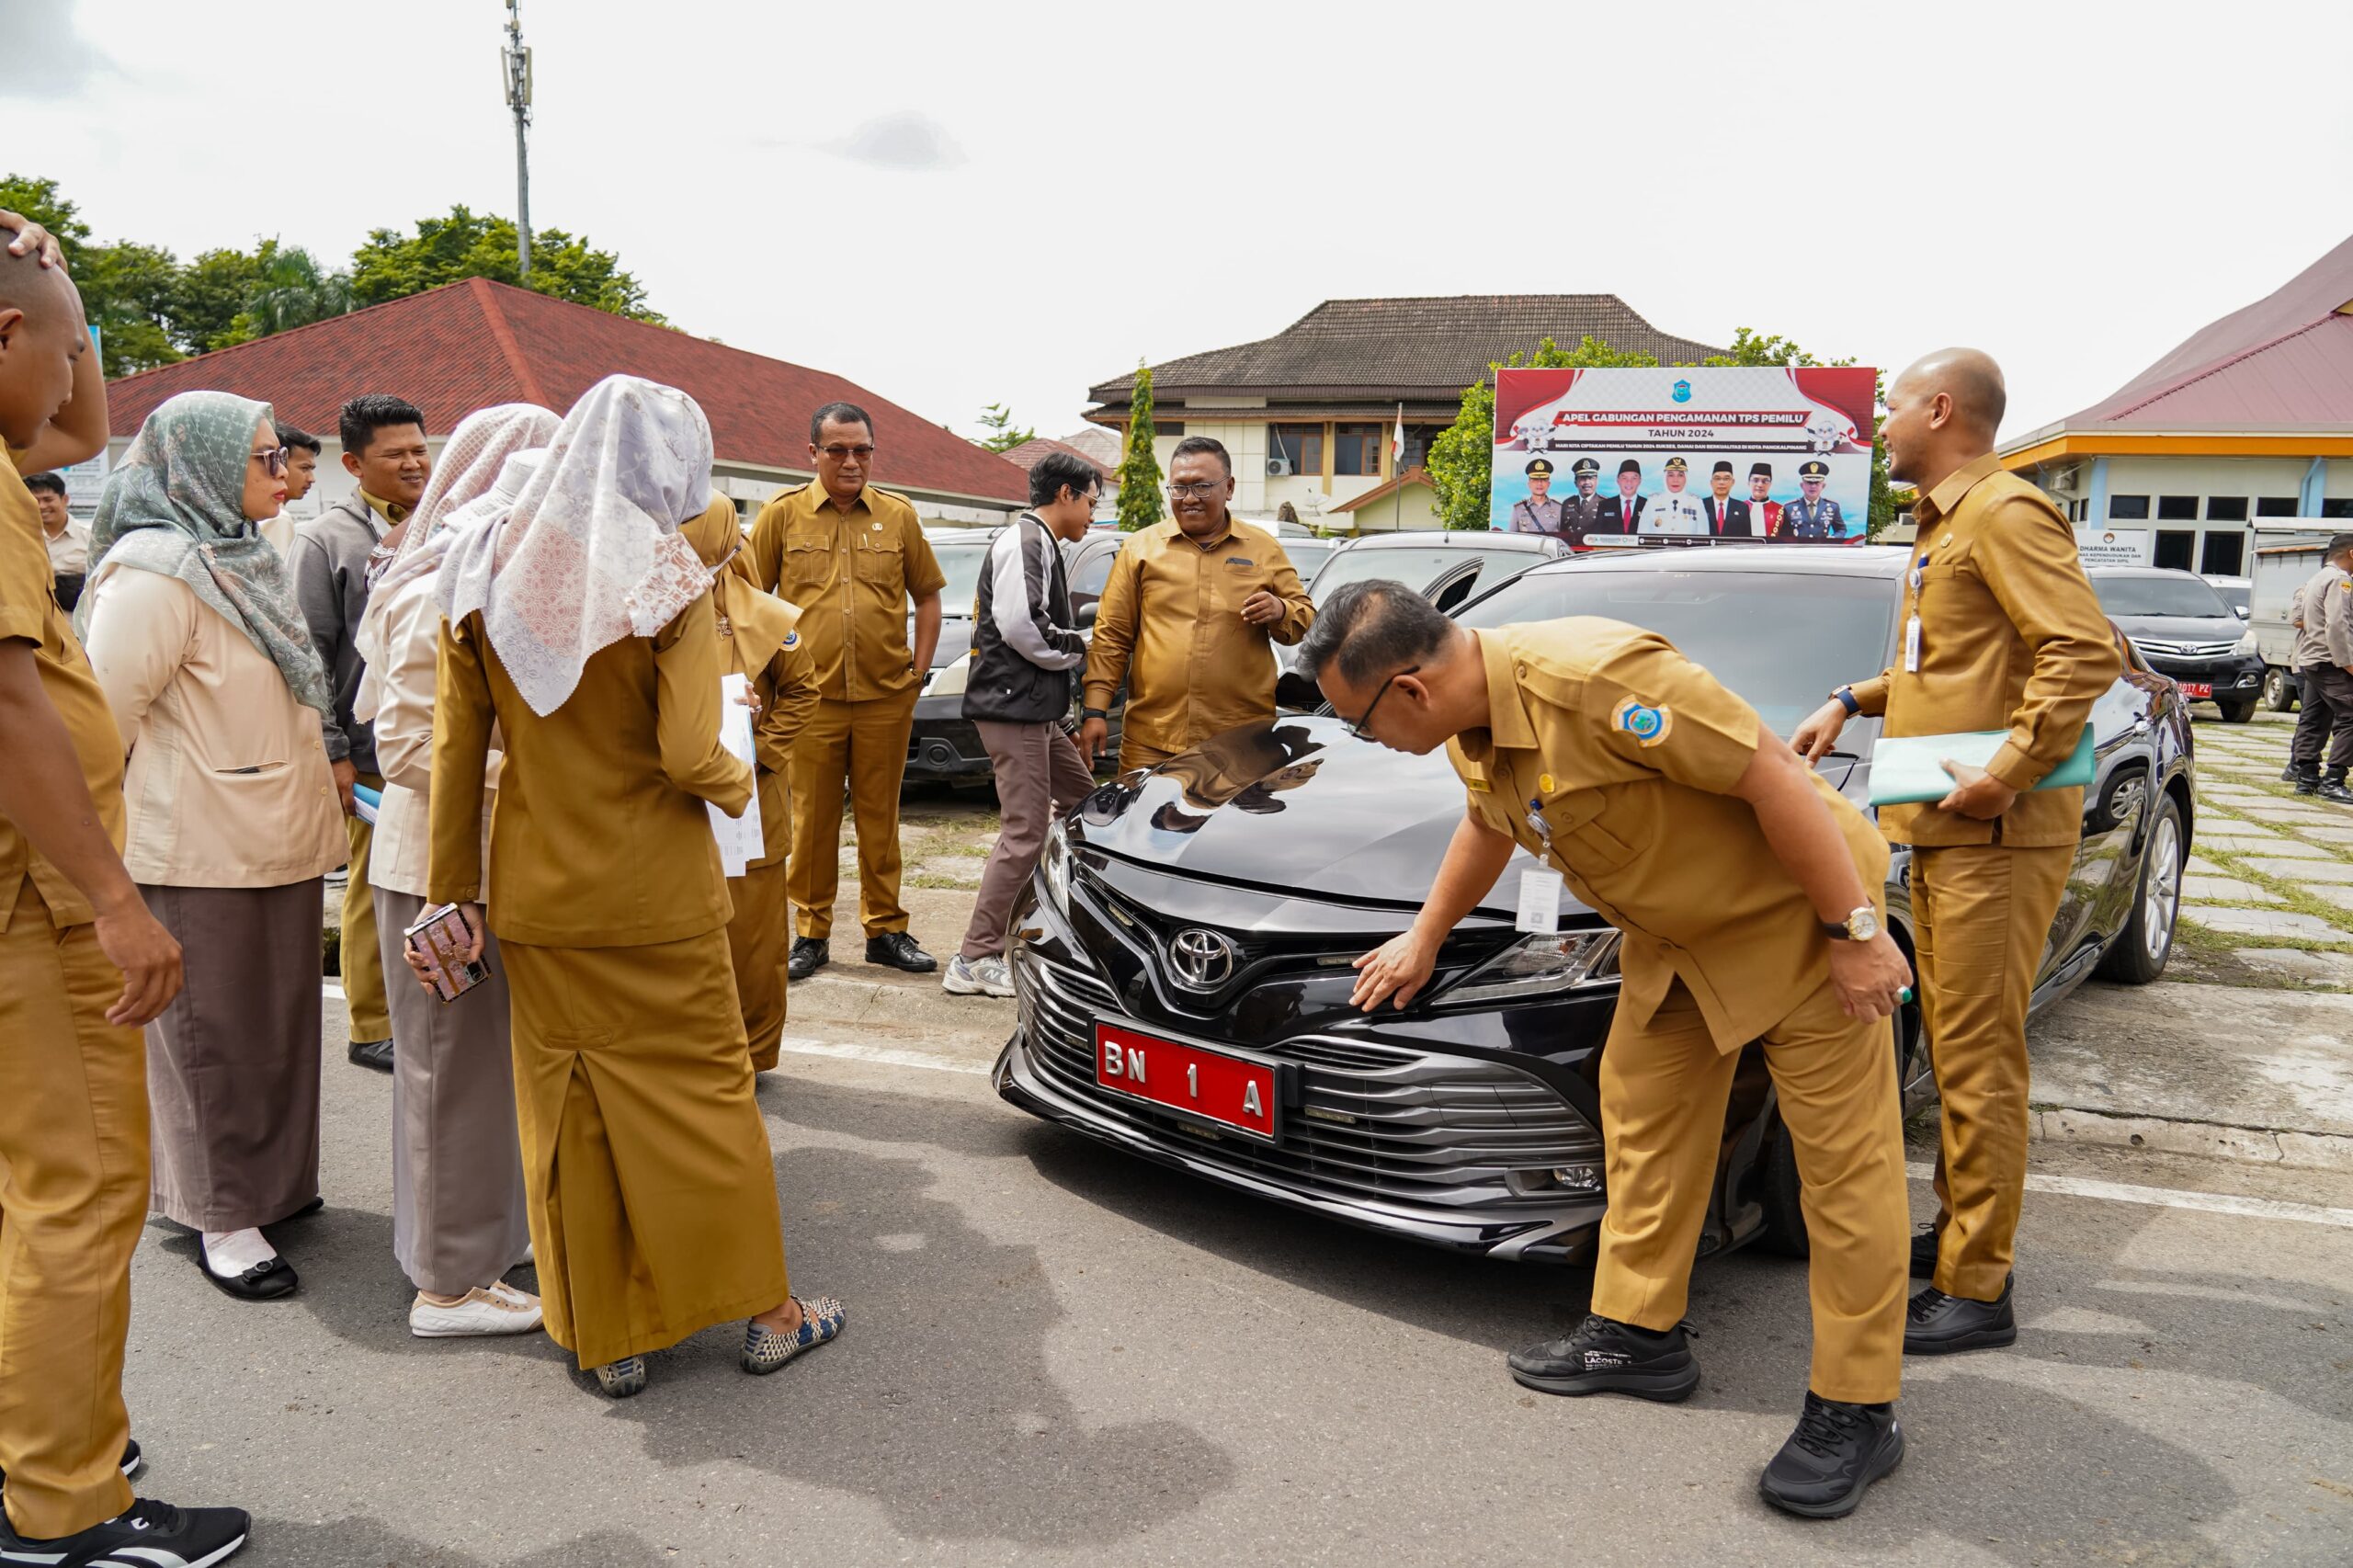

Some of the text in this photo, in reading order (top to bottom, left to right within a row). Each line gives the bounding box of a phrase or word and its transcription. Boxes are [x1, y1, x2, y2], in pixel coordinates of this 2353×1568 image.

[1563, 413, 1803, 424] APEL GABUNGAN PENGAMANAN TPS PEMILU
[1648, 429, 1714, 437] TAHUN 2024
[2199, 684, 2210, 693] PZ
[985, 969, 999, 980] N
[1105, 1040, 1263, 1118] BN 1 A
